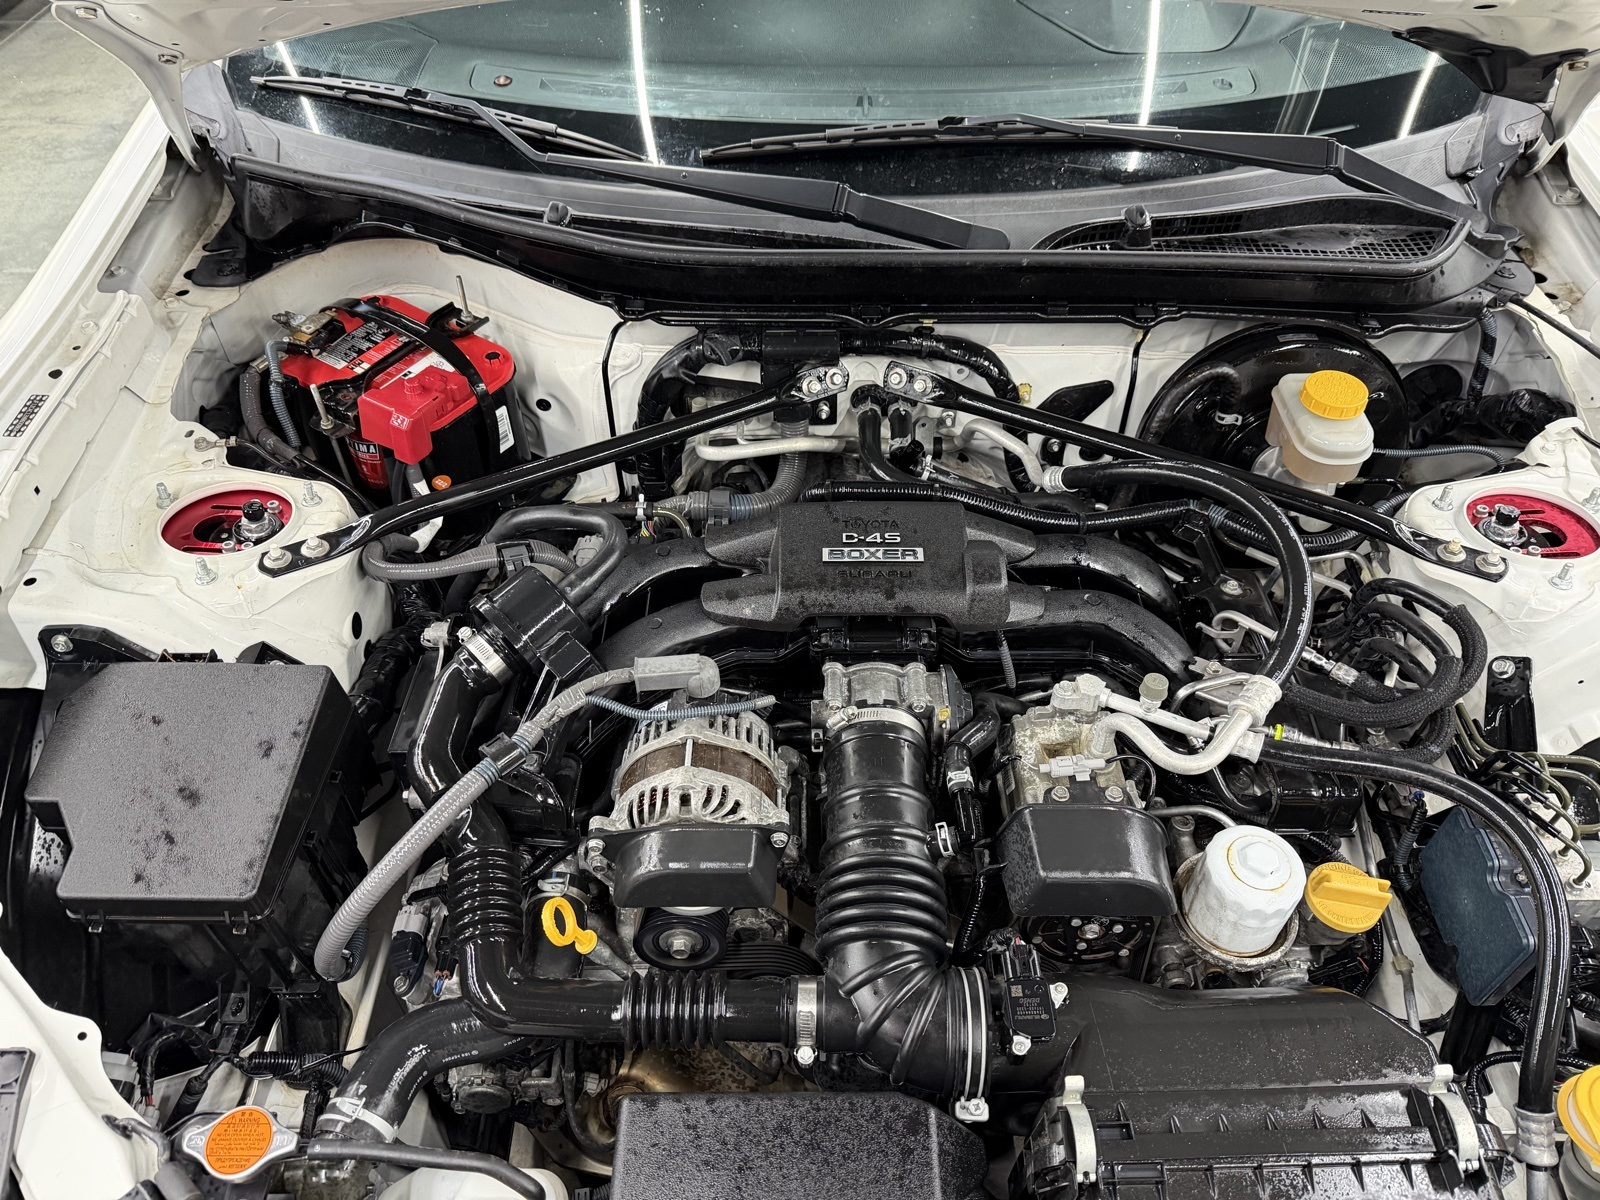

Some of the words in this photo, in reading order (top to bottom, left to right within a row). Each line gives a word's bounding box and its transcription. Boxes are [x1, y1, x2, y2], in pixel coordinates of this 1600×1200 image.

[842, 519, 900, 529] TOYOTA
[842, 532, 901, 543] D-4S
[827, 548, 919, 560] BOXER
[836, 570, 912, 579] SUBARU
[1316, 863, 1350, 873] ENGINE
